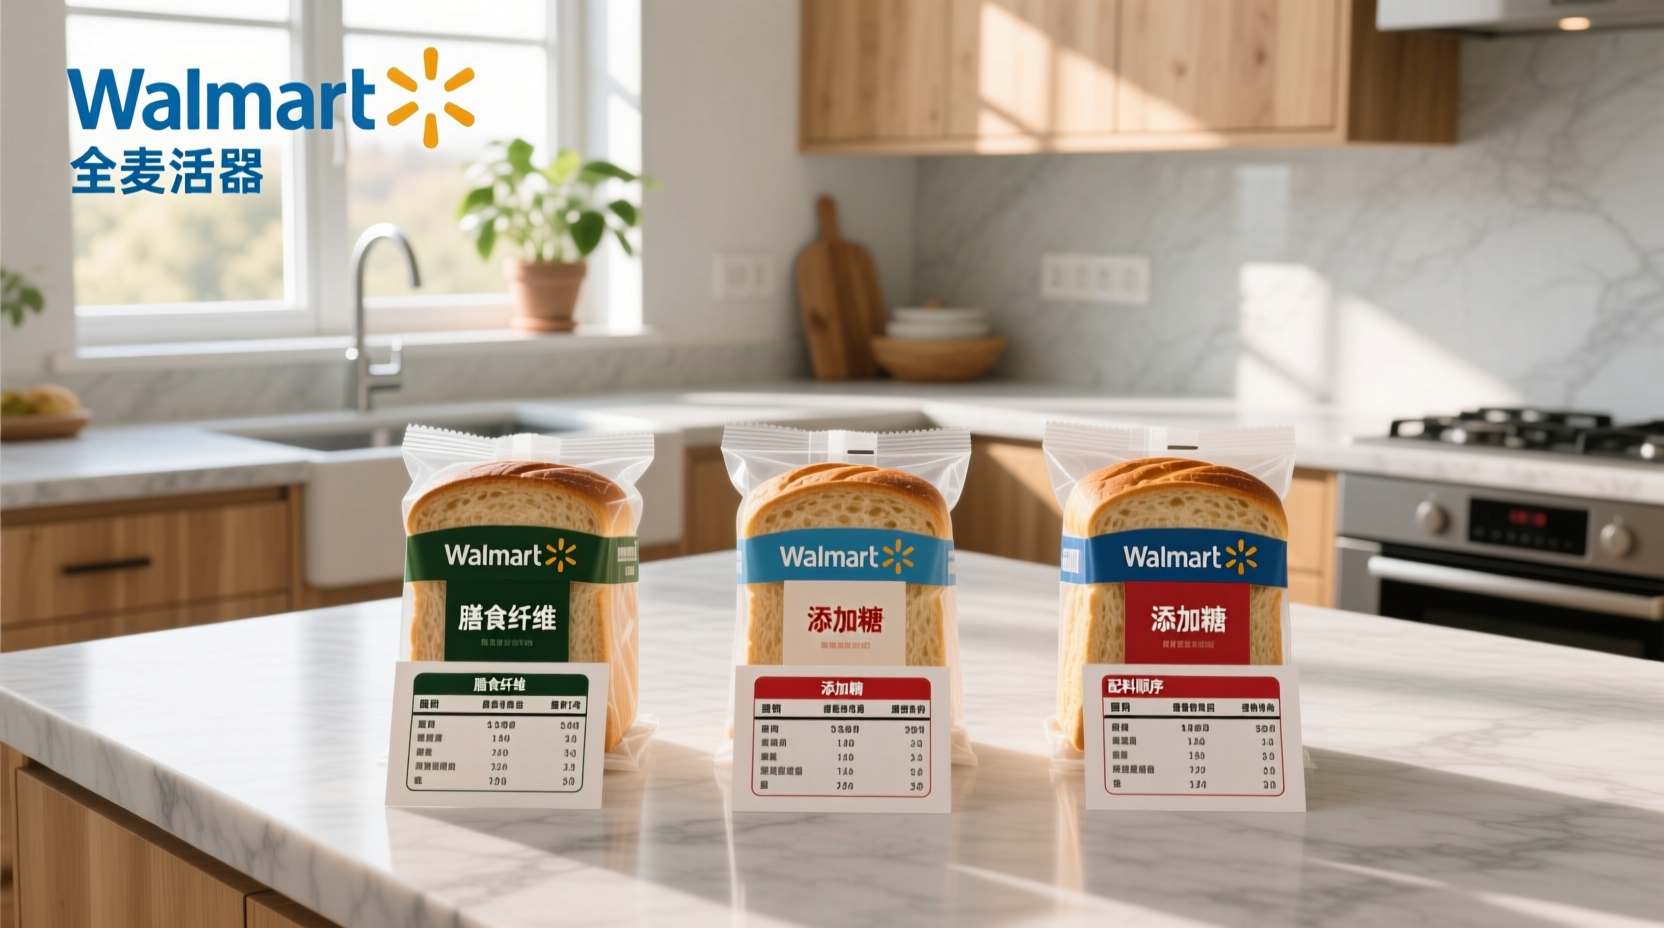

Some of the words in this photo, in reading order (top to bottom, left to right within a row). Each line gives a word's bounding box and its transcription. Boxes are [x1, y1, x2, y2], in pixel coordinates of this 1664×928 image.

[444, 543, 542, 566] Walmart
[779, 545, 879, 568] Walmart
[1123, 545, 1222, 569] Walmart
[458, 603, 557, 631] 膳食纤维
[807, 605, 884, 633] 添加糖
[1151, 605, 1227, 633] 添加糖
